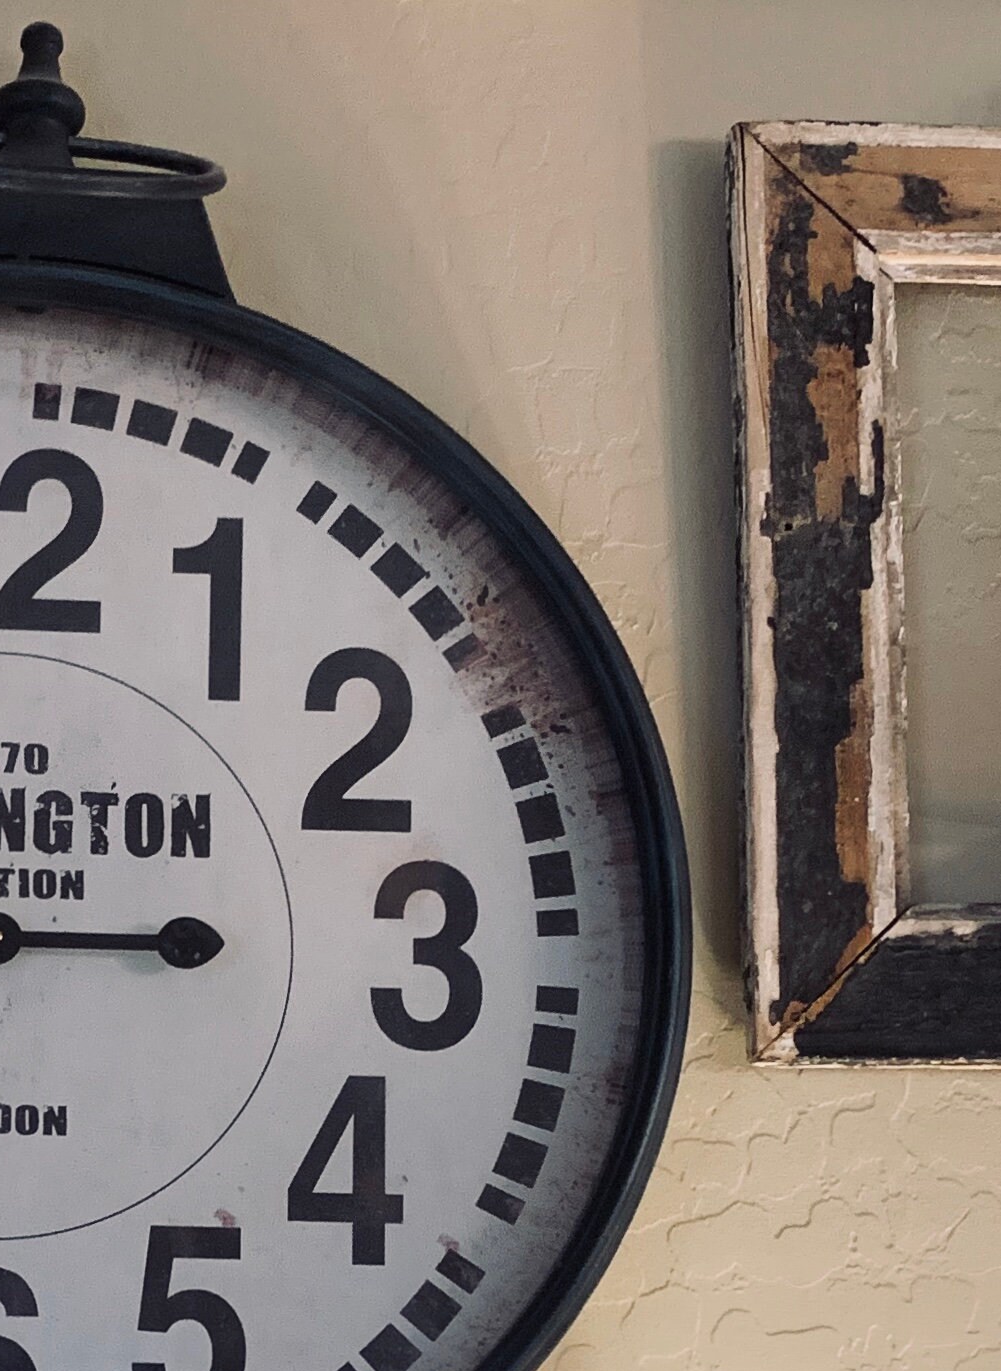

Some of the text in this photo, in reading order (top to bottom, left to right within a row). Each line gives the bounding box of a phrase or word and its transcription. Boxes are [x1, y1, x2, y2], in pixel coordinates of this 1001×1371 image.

[172, 517, 244, 702] 1
[301, 647, 413, 833] 2
[370, 859, 483, 1052] 3
[287, 1075, 404, 1266] 4
